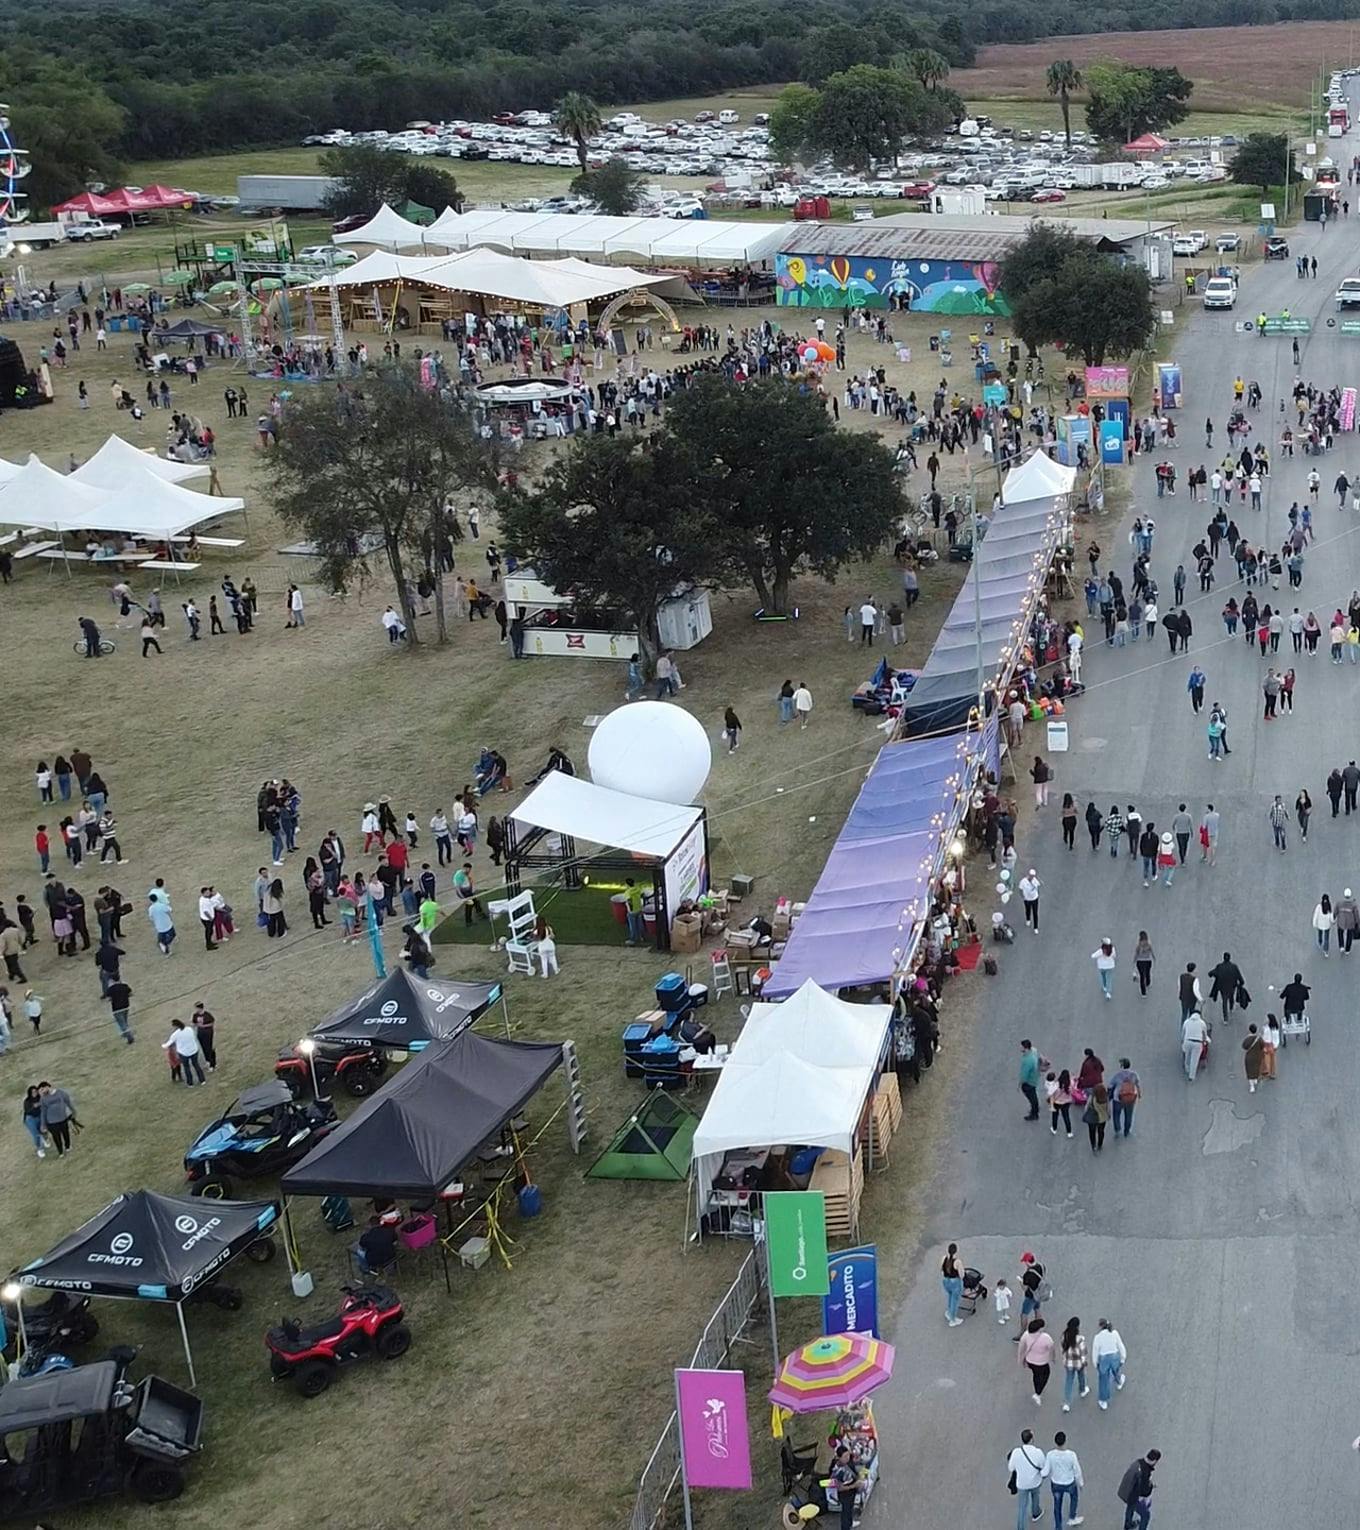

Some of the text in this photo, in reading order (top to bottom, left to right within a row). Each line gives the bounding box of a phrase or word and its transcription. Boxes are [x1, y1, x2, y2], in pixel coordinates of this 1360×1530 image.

[363, 1016, 408, 1025] CFMOTO
[181, 1216, 222, 1251] CFMOTO
[87, 1253, 144, 1268] CFMOTO
[193, 1247, 231, 1283] CFMOTO
[36, 1279, 92, 1290] CFMOTO
[844, 1265, 856, 1331] MERCADITO
